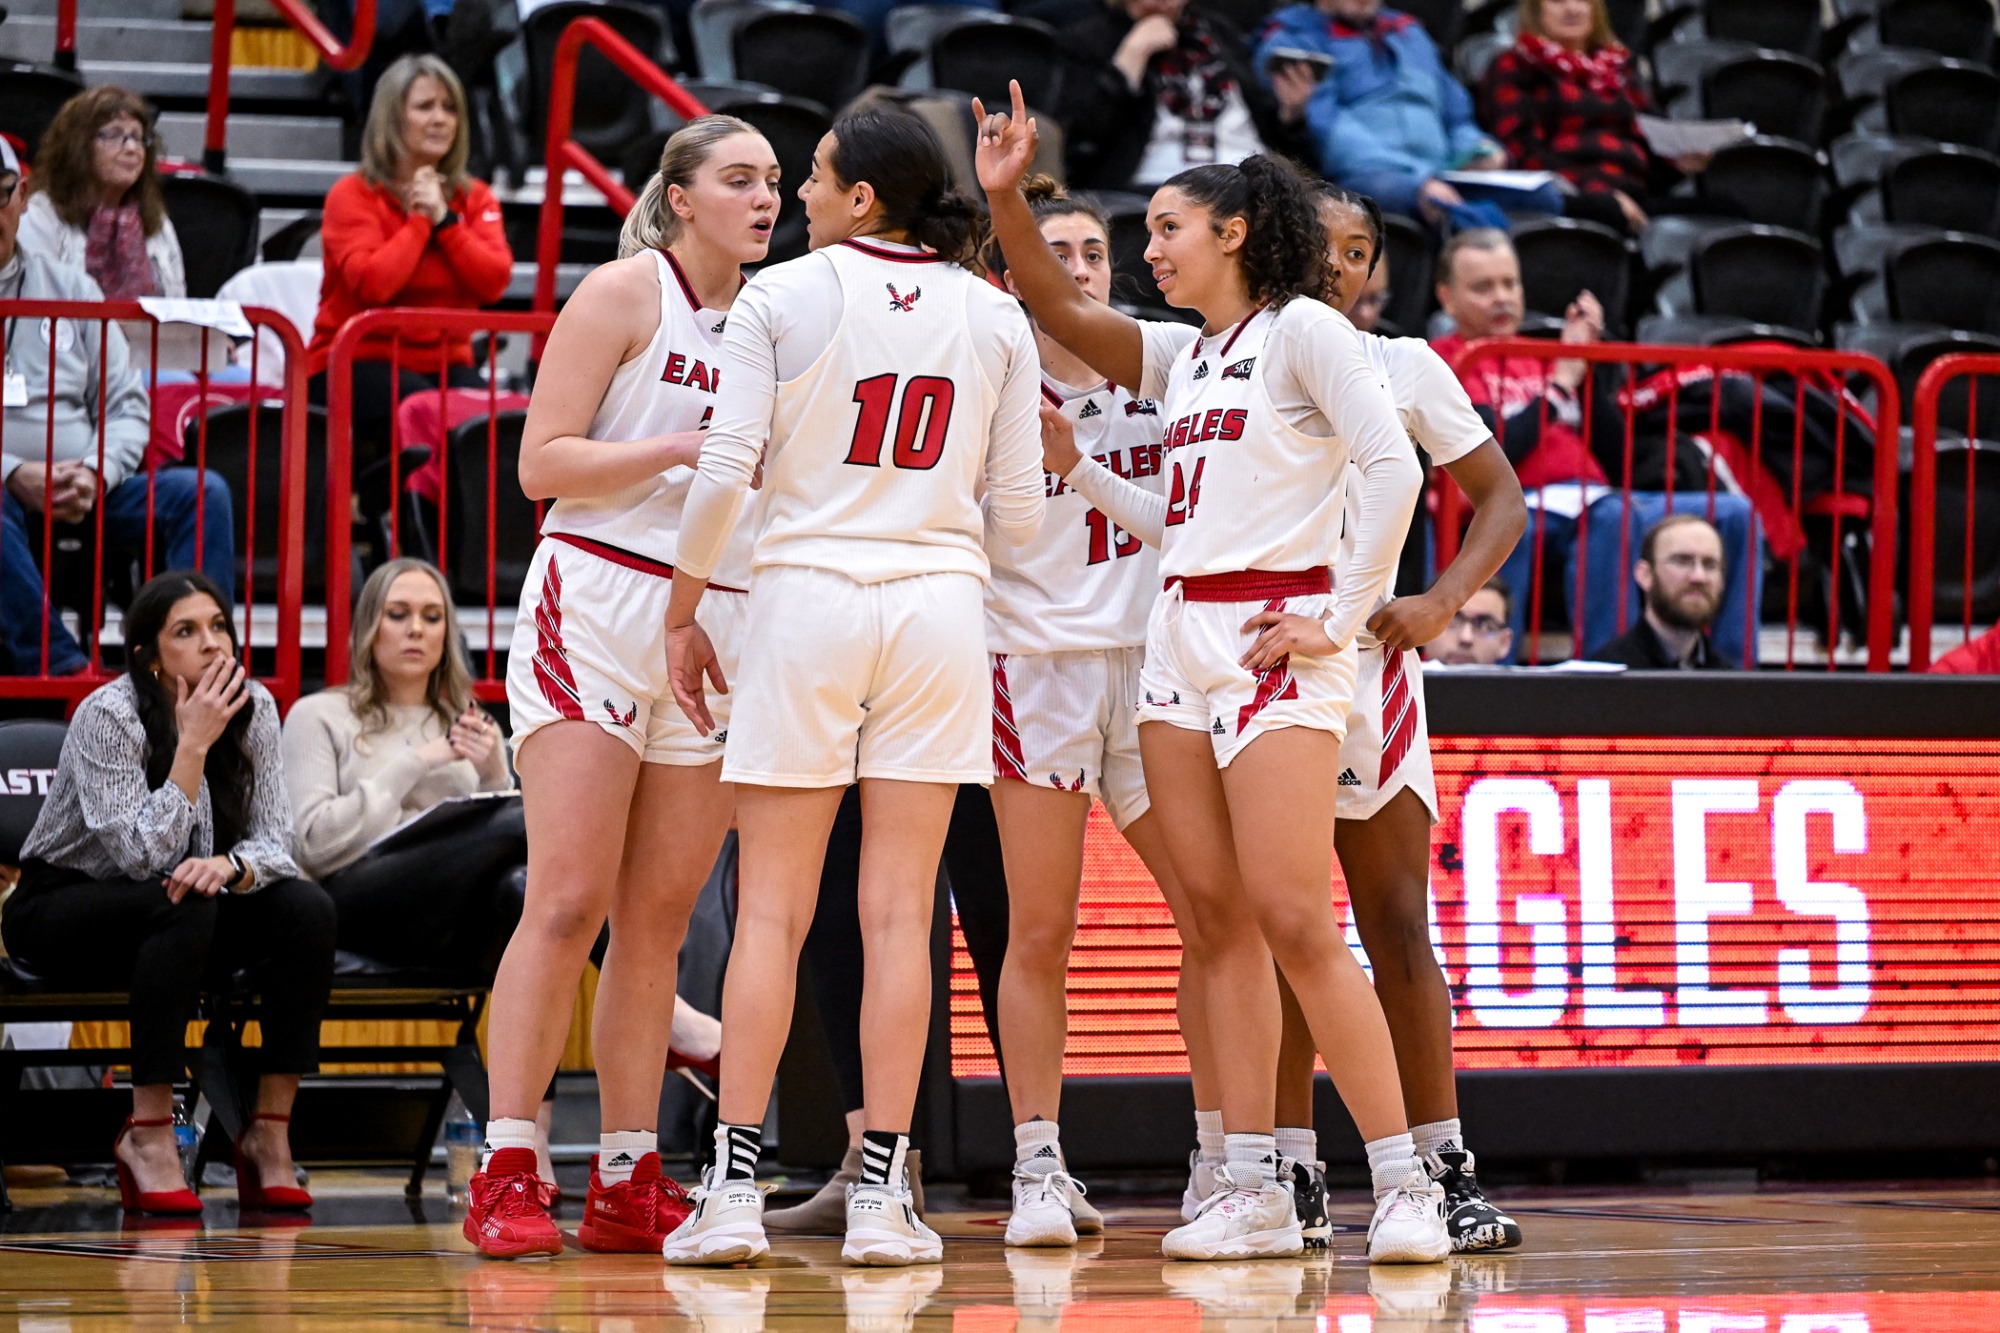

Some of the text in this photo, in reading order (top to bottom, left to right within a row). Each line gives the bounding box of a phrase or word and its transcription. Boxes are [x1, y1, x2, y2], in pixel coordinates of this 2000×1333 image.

[842, 372, 955, 470] 10
[1079, 408, 1102, 419] adidas
[1165, 456, 1206, 527] 24
[1345, 779, 1872, 1027] GLES
